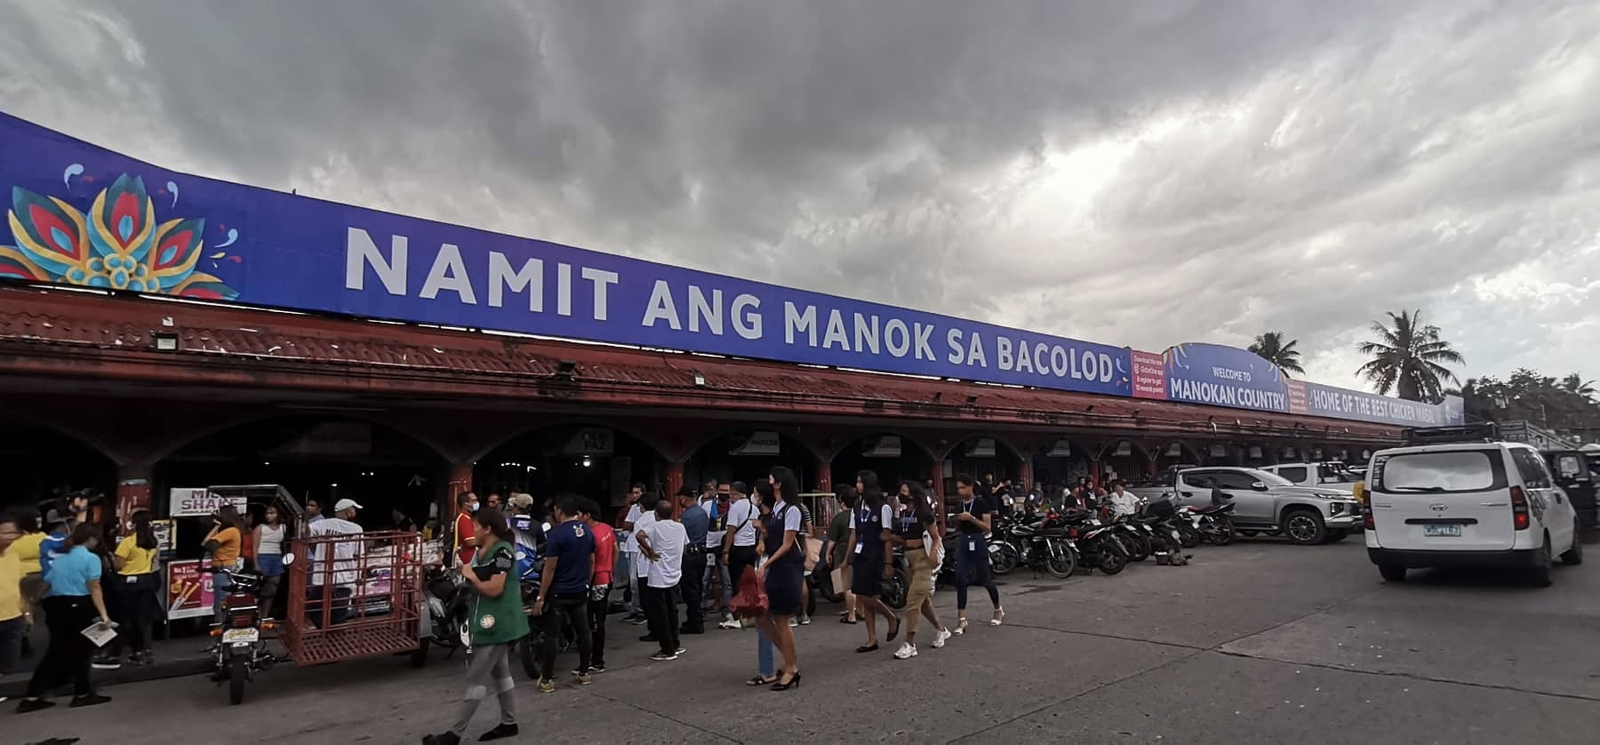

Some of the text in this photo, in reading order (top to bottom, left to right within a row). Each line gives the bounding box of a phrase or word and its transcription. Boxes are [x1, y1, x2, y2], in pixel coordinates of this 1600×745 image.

[345, 227, 1113, 383] NAMIT ANG MANOK SA BACOLOD
[1212, 366, 1252, 383] WELCOME TO
[1170, 377, 1236, 405] MANOKAN
[1238, 387, 1285, 410] COUNTRY
[1313, 389, 1341, 412] HOME
[1342, 394, 1354, 414] OF
[1354, 396, 1371, 416] THE
[1371, 399, 1388, 418] BEST
[1389, 401, 1416, 421] CHICKEN
